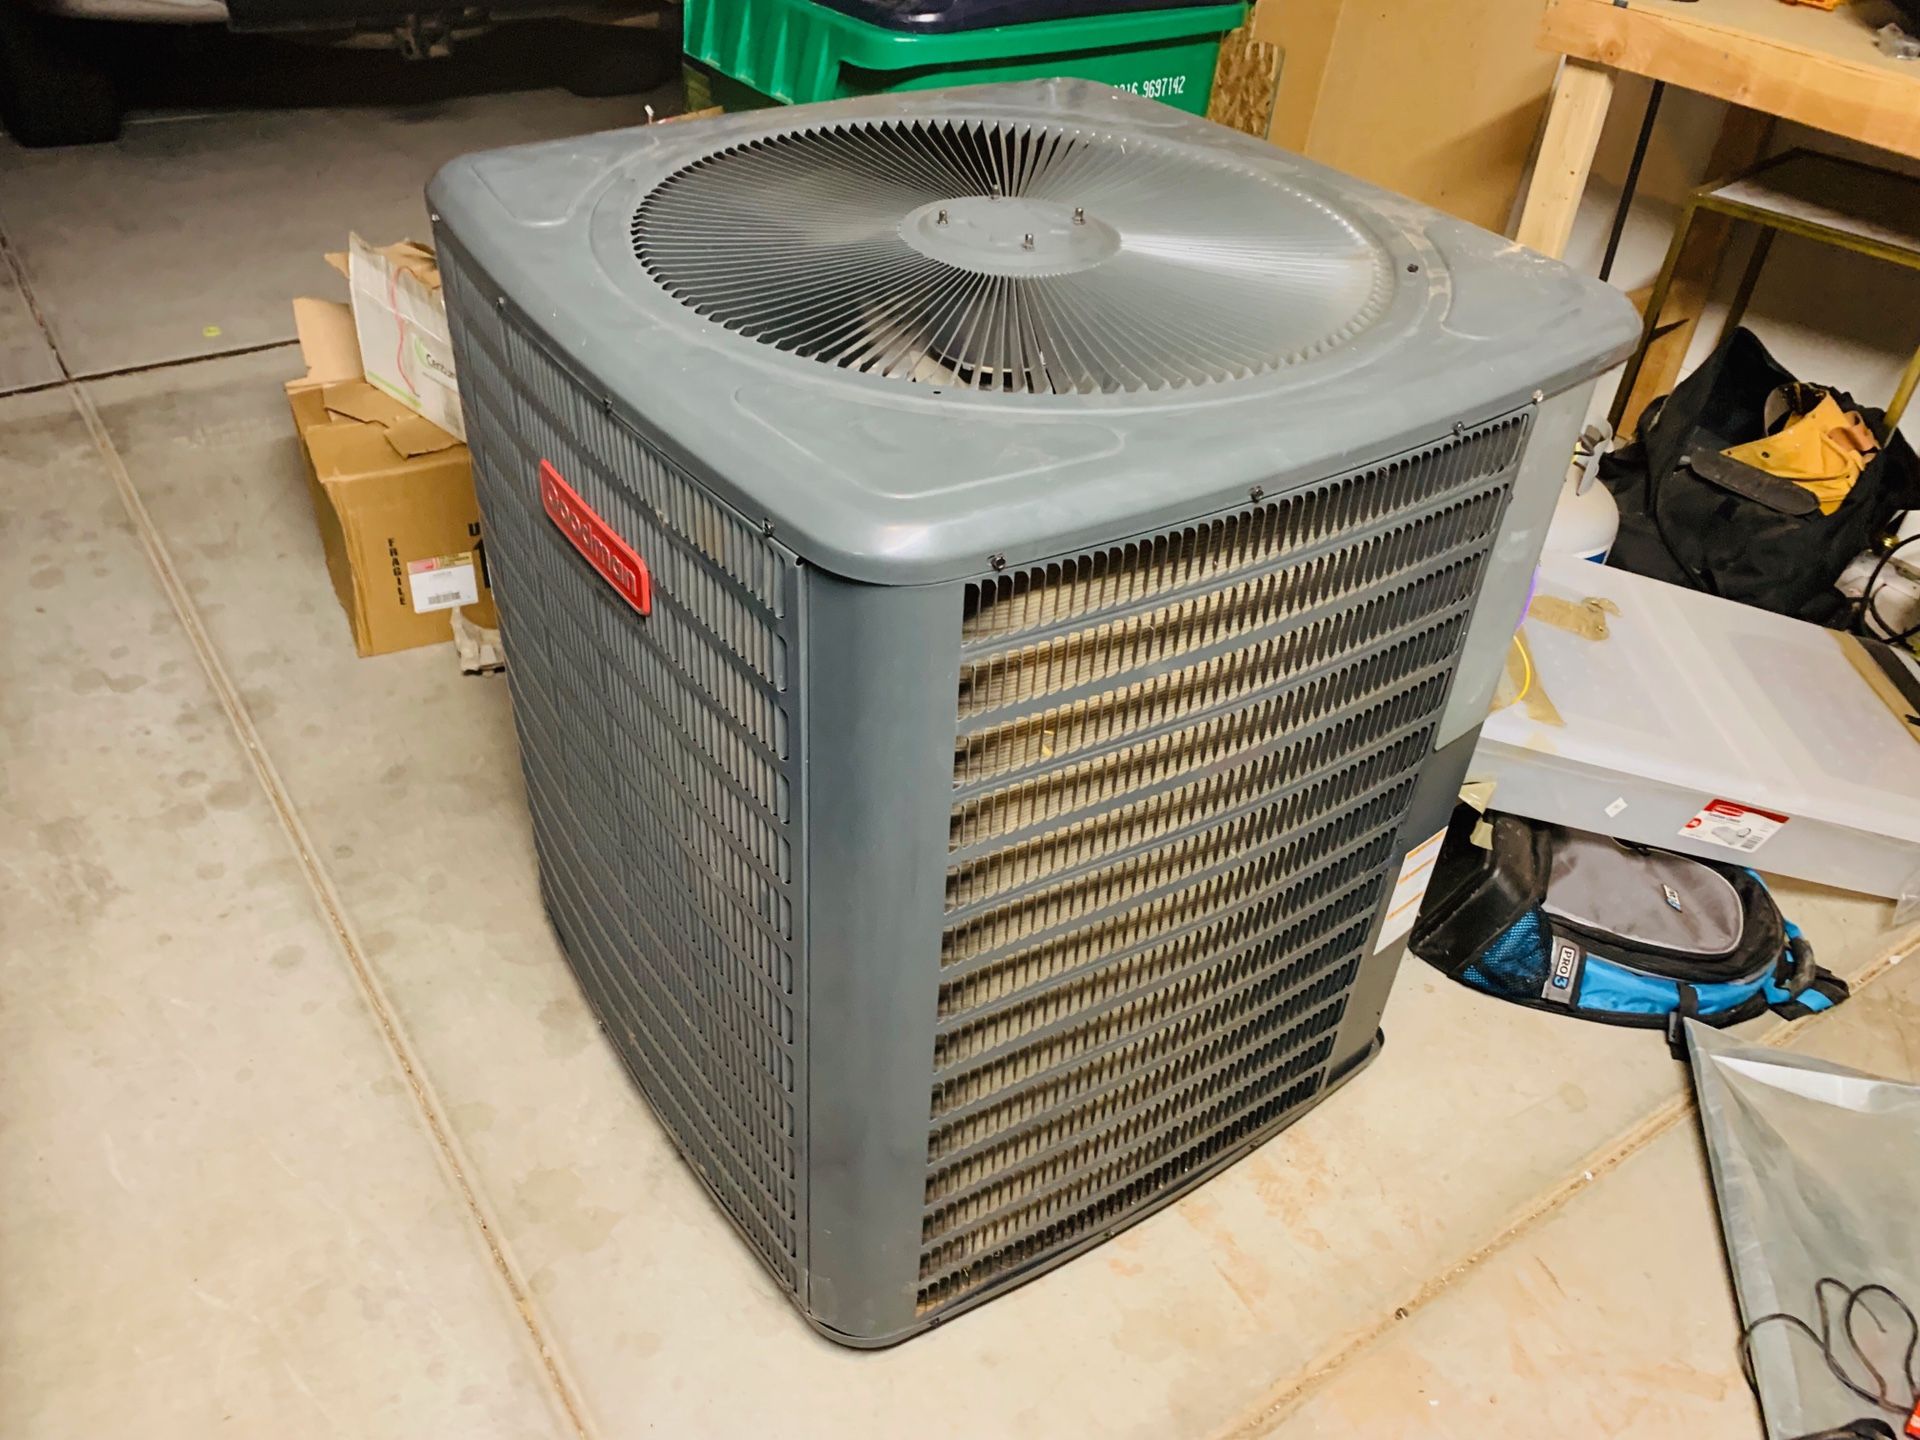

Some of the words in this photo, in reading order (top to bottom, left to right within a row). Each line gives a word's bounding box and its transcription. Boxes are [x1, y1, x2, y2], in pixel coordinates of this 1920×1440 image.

[1113, 82, 1138, 95] 16
[1142, 75, 1186, 98] 9697142
[387, 538, 406, 606] FRAGILE
[546, 479, 638, 598] Goodman
